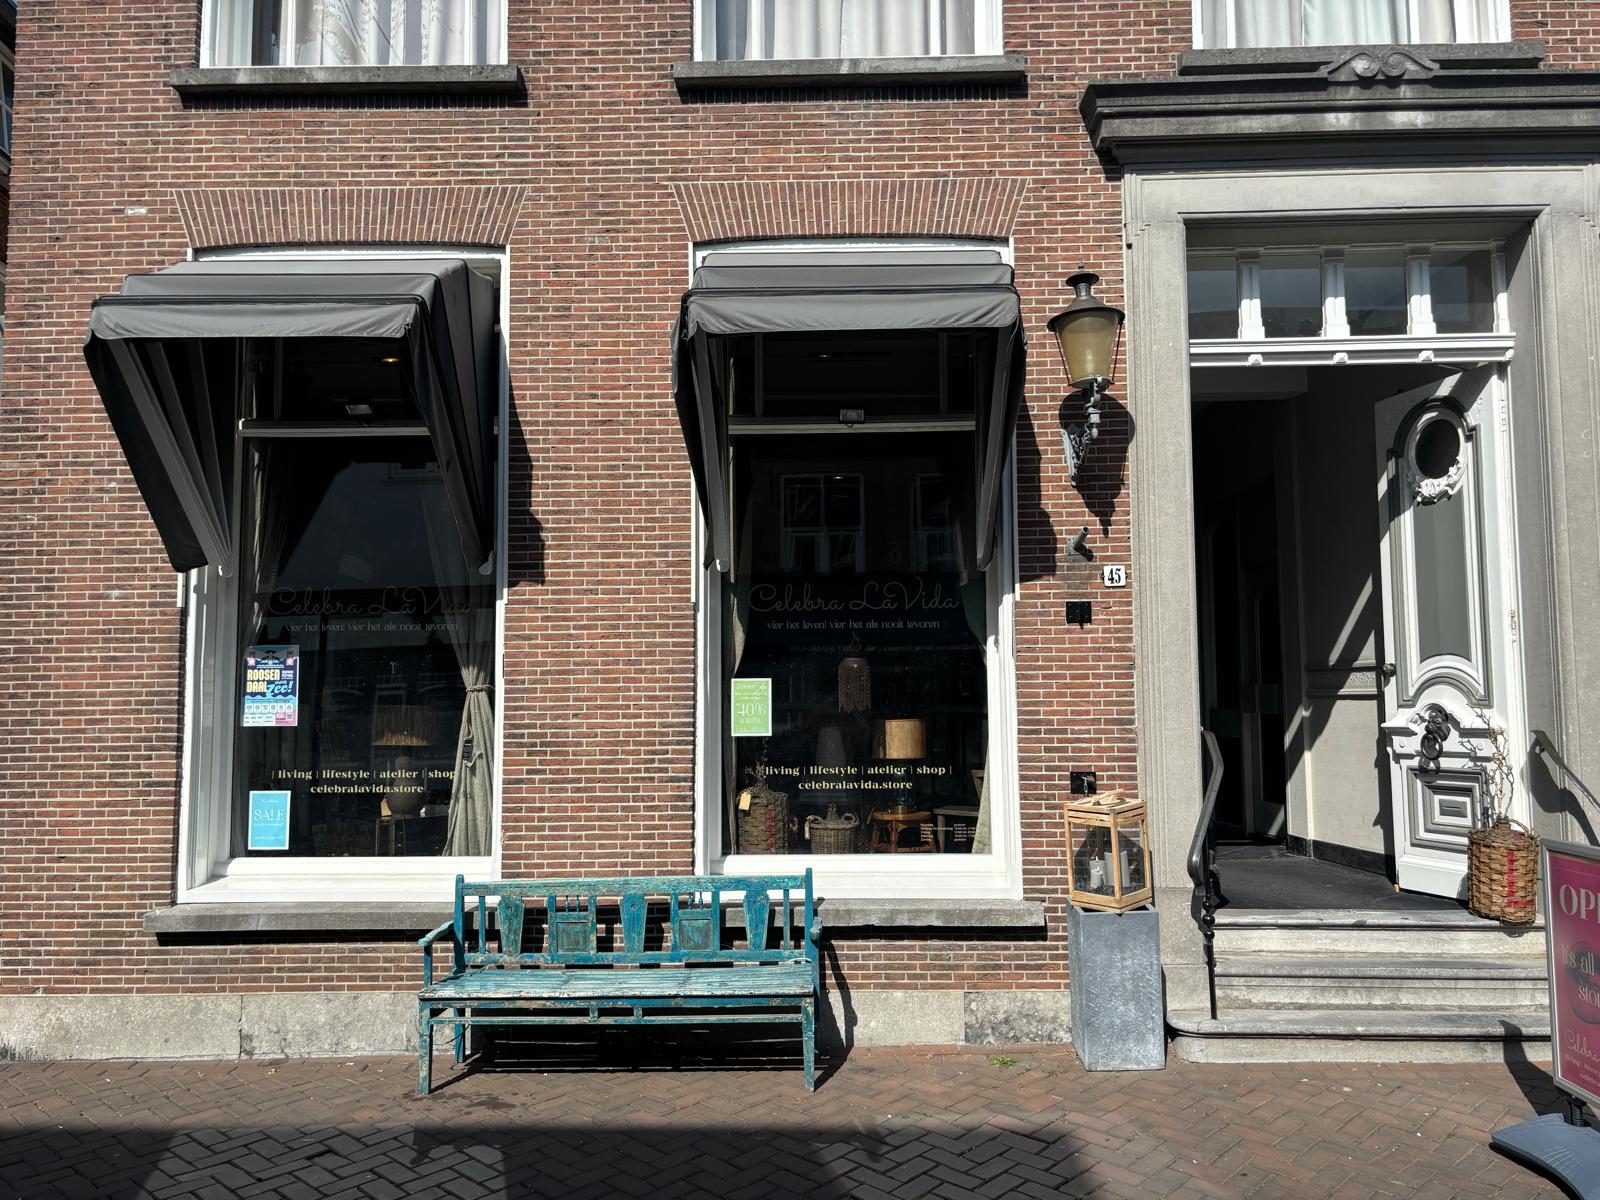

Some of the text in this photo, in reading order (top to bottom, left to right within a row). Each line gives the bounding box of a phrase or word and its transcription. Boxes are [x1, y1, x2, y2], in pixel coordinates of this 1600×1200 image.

[1108, 568, 1122, 584] 45
[267, 586, 363, 615] Celebra
[748, 576, 960, 611] Celebra La Vida
[767, 619, 784, 630] vier
[786, 619, 800, 630] het
[830, 619, 846, 630] vier
[849, 619, 863, 630] het
[866, 619, 879, 629] als
[881, 619, 904, 629] nooit
[907, 619, 941, 629] tevoren
[278, 769, 313, 780] living
[322, 769, 370, 781] lifestyle
[379, 769, 419, 779] atelier
[428, 769, 457, 781] shop
[765, 765, 800, 777] living
[809, 765, 858, 777] lifestyle
[867, 765, 907, 775] atelier
[916, 765, 946, 776] shop
[310, 784, 424, 794] celebralavida.store
[798, 780, 913, 790] celebralavida.store
[1559, 884, 1600, 923] OP
[1580, 952, 1595, 976] all
